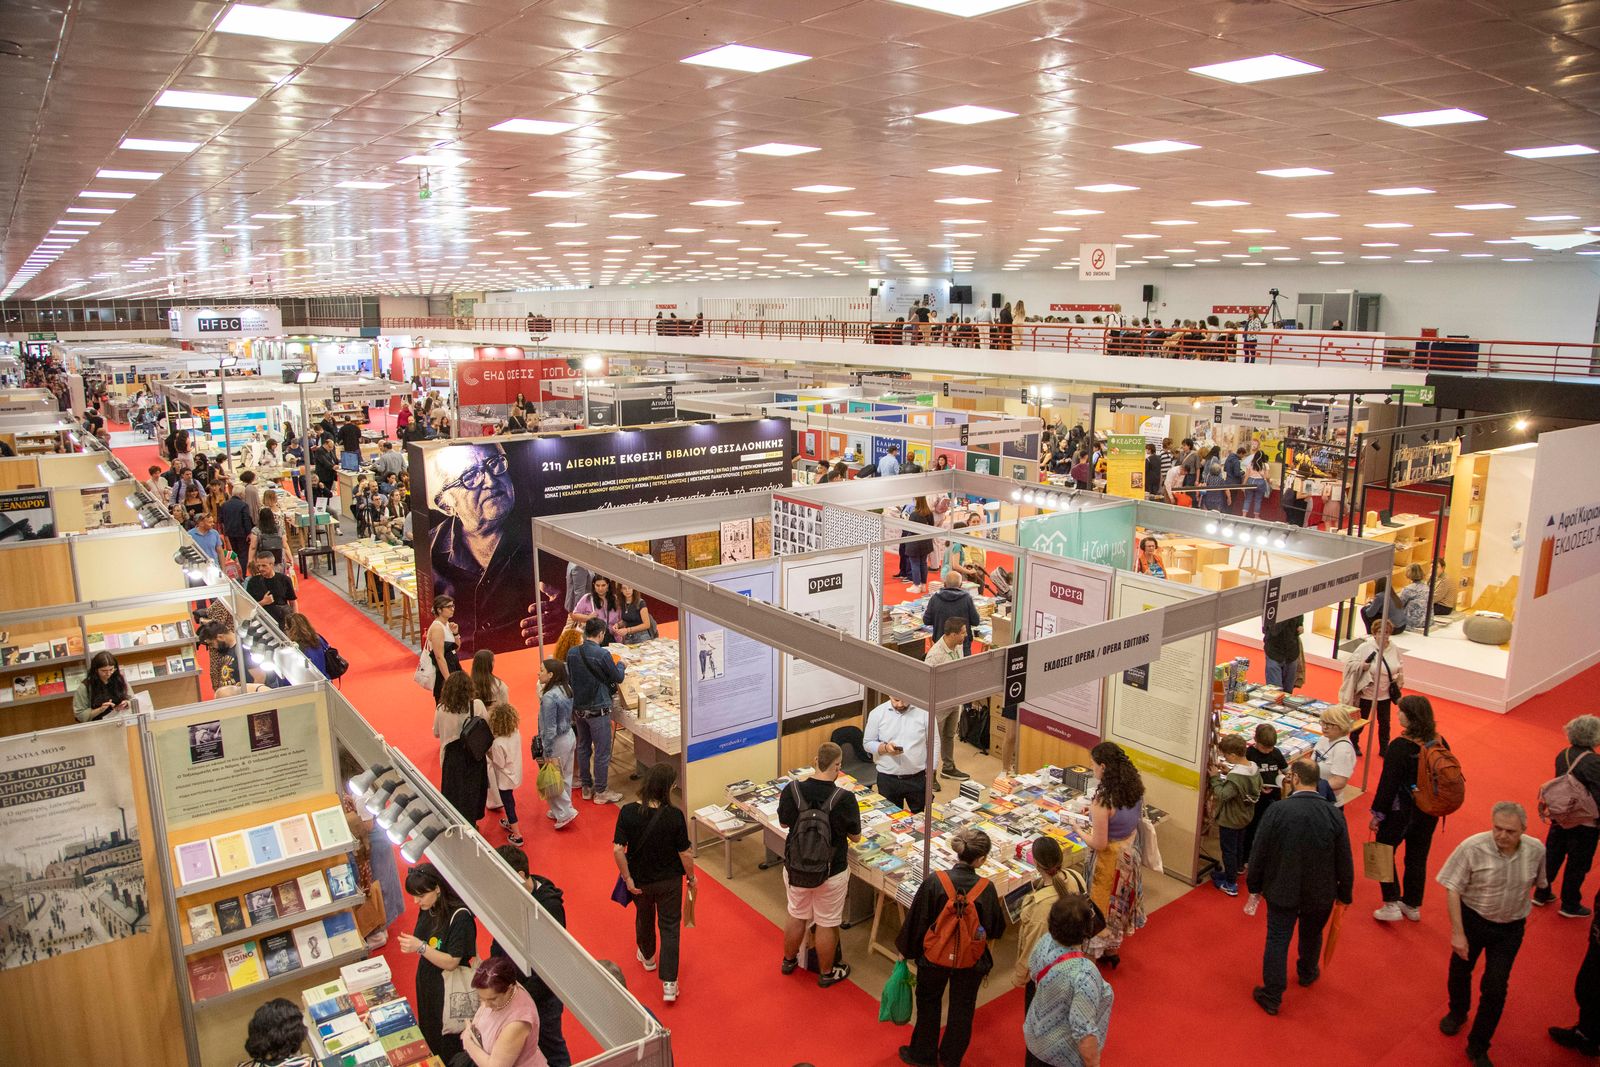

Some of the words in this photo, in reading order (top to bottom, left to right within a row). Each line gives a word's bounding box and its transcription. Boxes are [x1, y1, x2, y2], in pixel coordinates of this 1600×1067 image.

[200, 320, 240, 330] HFBC
[484, 369, 534, 380] ΕΚΔΟΣΕΙΣ
[542, 461, 562, 472] 21η
[566, 455, 616, 469] ΔΙΕΘΝΗΣ
[620, 452, 662, 464] ΕΚΘΕΣΗ
[666, 446, 706, 459] ΒΙΒΛΙΟΥ
[710, 438, 784, 454] ΘΕΣΣΑΛΟΝΙΚΗΣ
[1558, 508, 1578, 532] Αφοί
[1083, 541, 1089, 560] Η
[1110, 540, 1126, 561] μας
[1554, 528, 1594, 556] ΕΚΔΟΣΕΙΣ
[809, 576, 842, 593] opera
[1051, 584, 1083, 602] opera
[1044, 655, 1073, 672] ΕΚΔΟΣΕΙΣ
[1075, 650, 1094, 663] OPERA
[1102, 642, 1121, 655] OPERA
[1124, 633, 1150, 650] EDITIONS
[1012, 662, 1024, 670] 025
[6, 752, 39, 762] ΣΑΝΤΑΛ
[41, 746, 66, 755] ΜΟΥΦ
[18, 768, 39, 779] ΜΙΑ
[42, 757, 93, 774] ΠΡΑΣΙΝΗ
[2, 784, 80, 807] ΕΠΑΝΑΣΤΑΣΗ
[228, 951, 253, 964] ΚΟΙΝΟ
